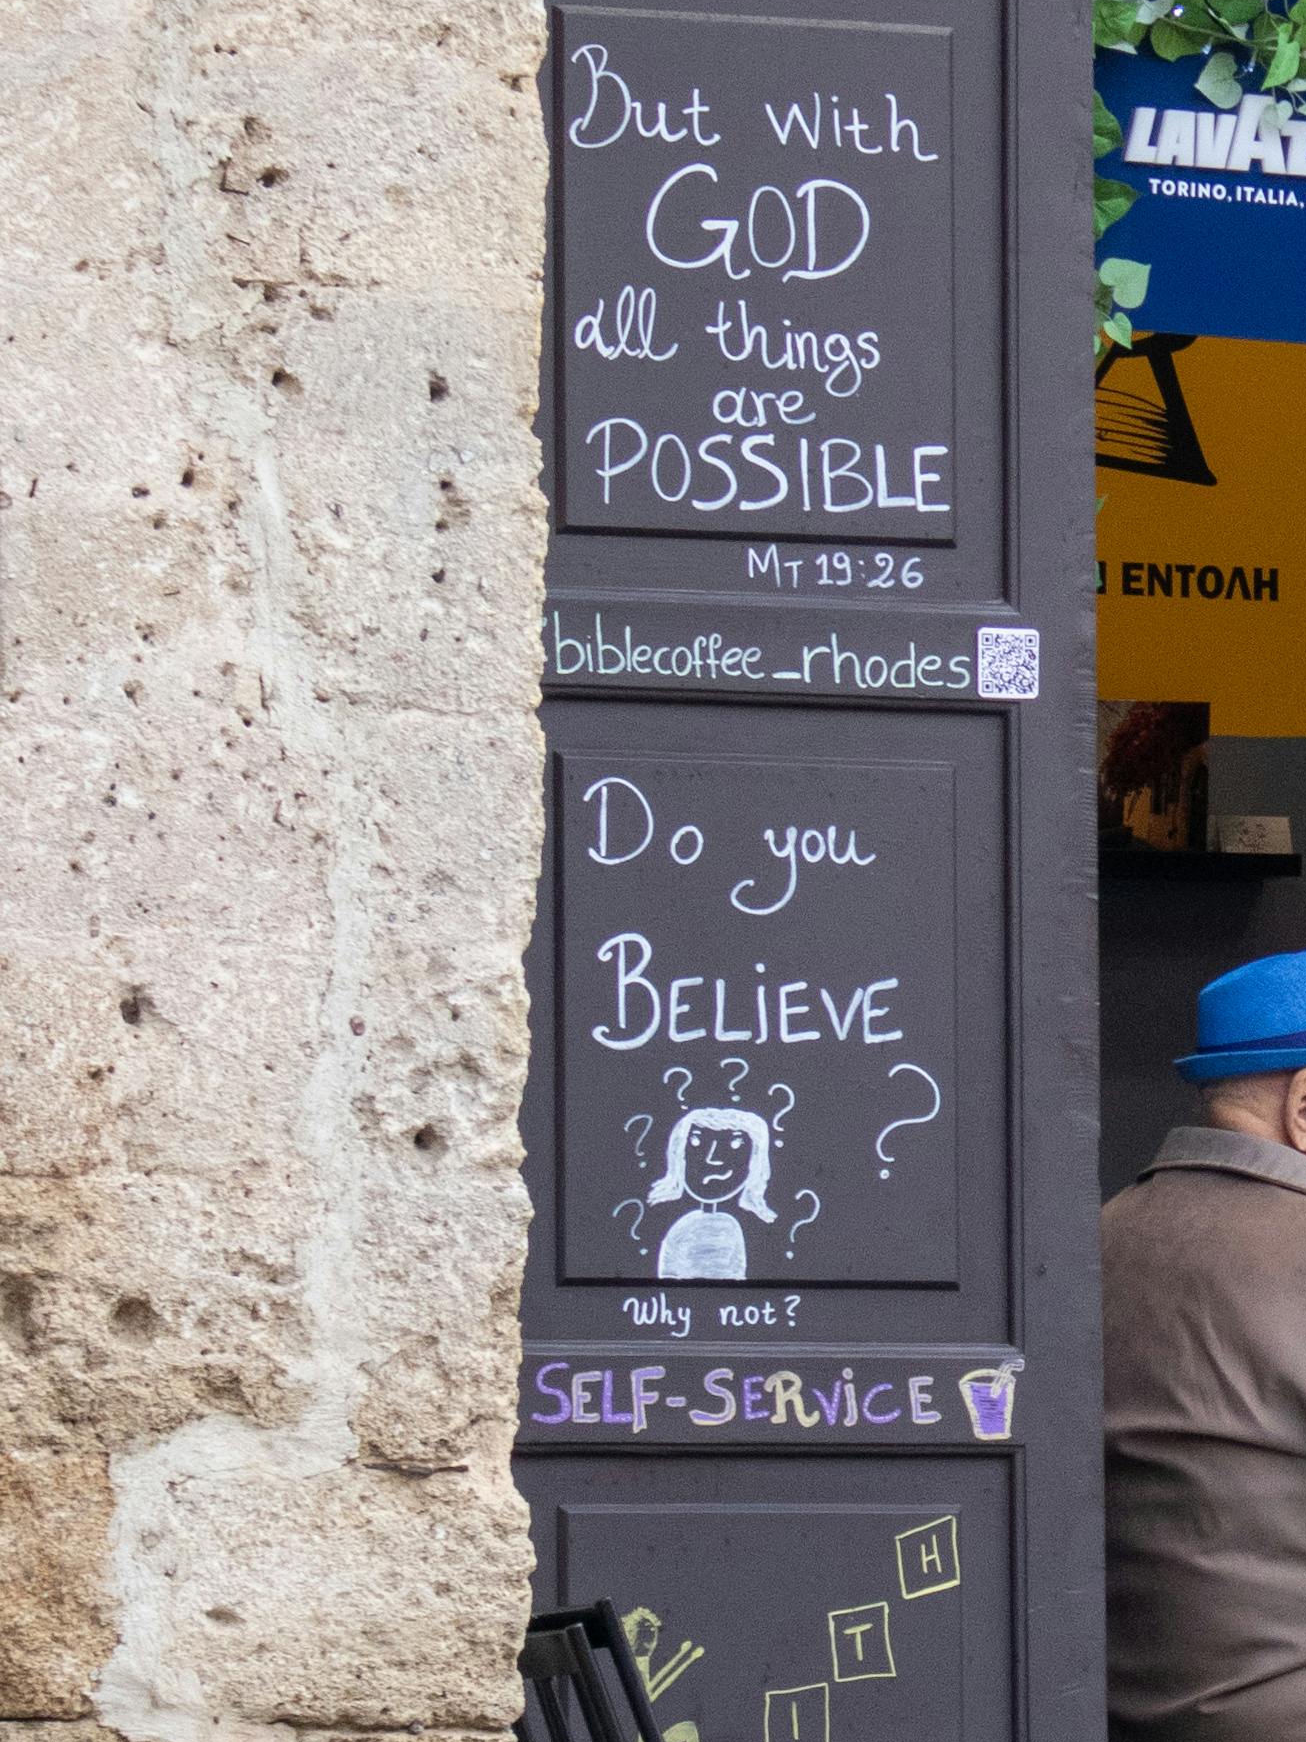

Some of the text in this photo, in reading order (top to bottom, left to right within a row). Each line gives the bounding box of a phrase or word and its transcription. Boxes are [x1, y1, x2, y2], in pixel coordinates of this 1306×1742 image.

[569, 43, 720, 148] But
[645, 163, 870, 282] GOD
[1148, 178, 1233, 204] TORINO,
[1236, 186, 1304, 210] ITALIA,
[706, 300, 880, 398] things
[712, 386, 816, 428] are
[586, 418, 949, 512] POSSIBLE
[815, 552, 924, 589] 19:26
[1122, 562, 1279, 602] ΕΝΤΟΛΗ
[541, 610, 971, 689] biblecoffee_rhodes
[584, 777, 876, 915] Do you
[623, 1294, 802, 1337] Why not?
